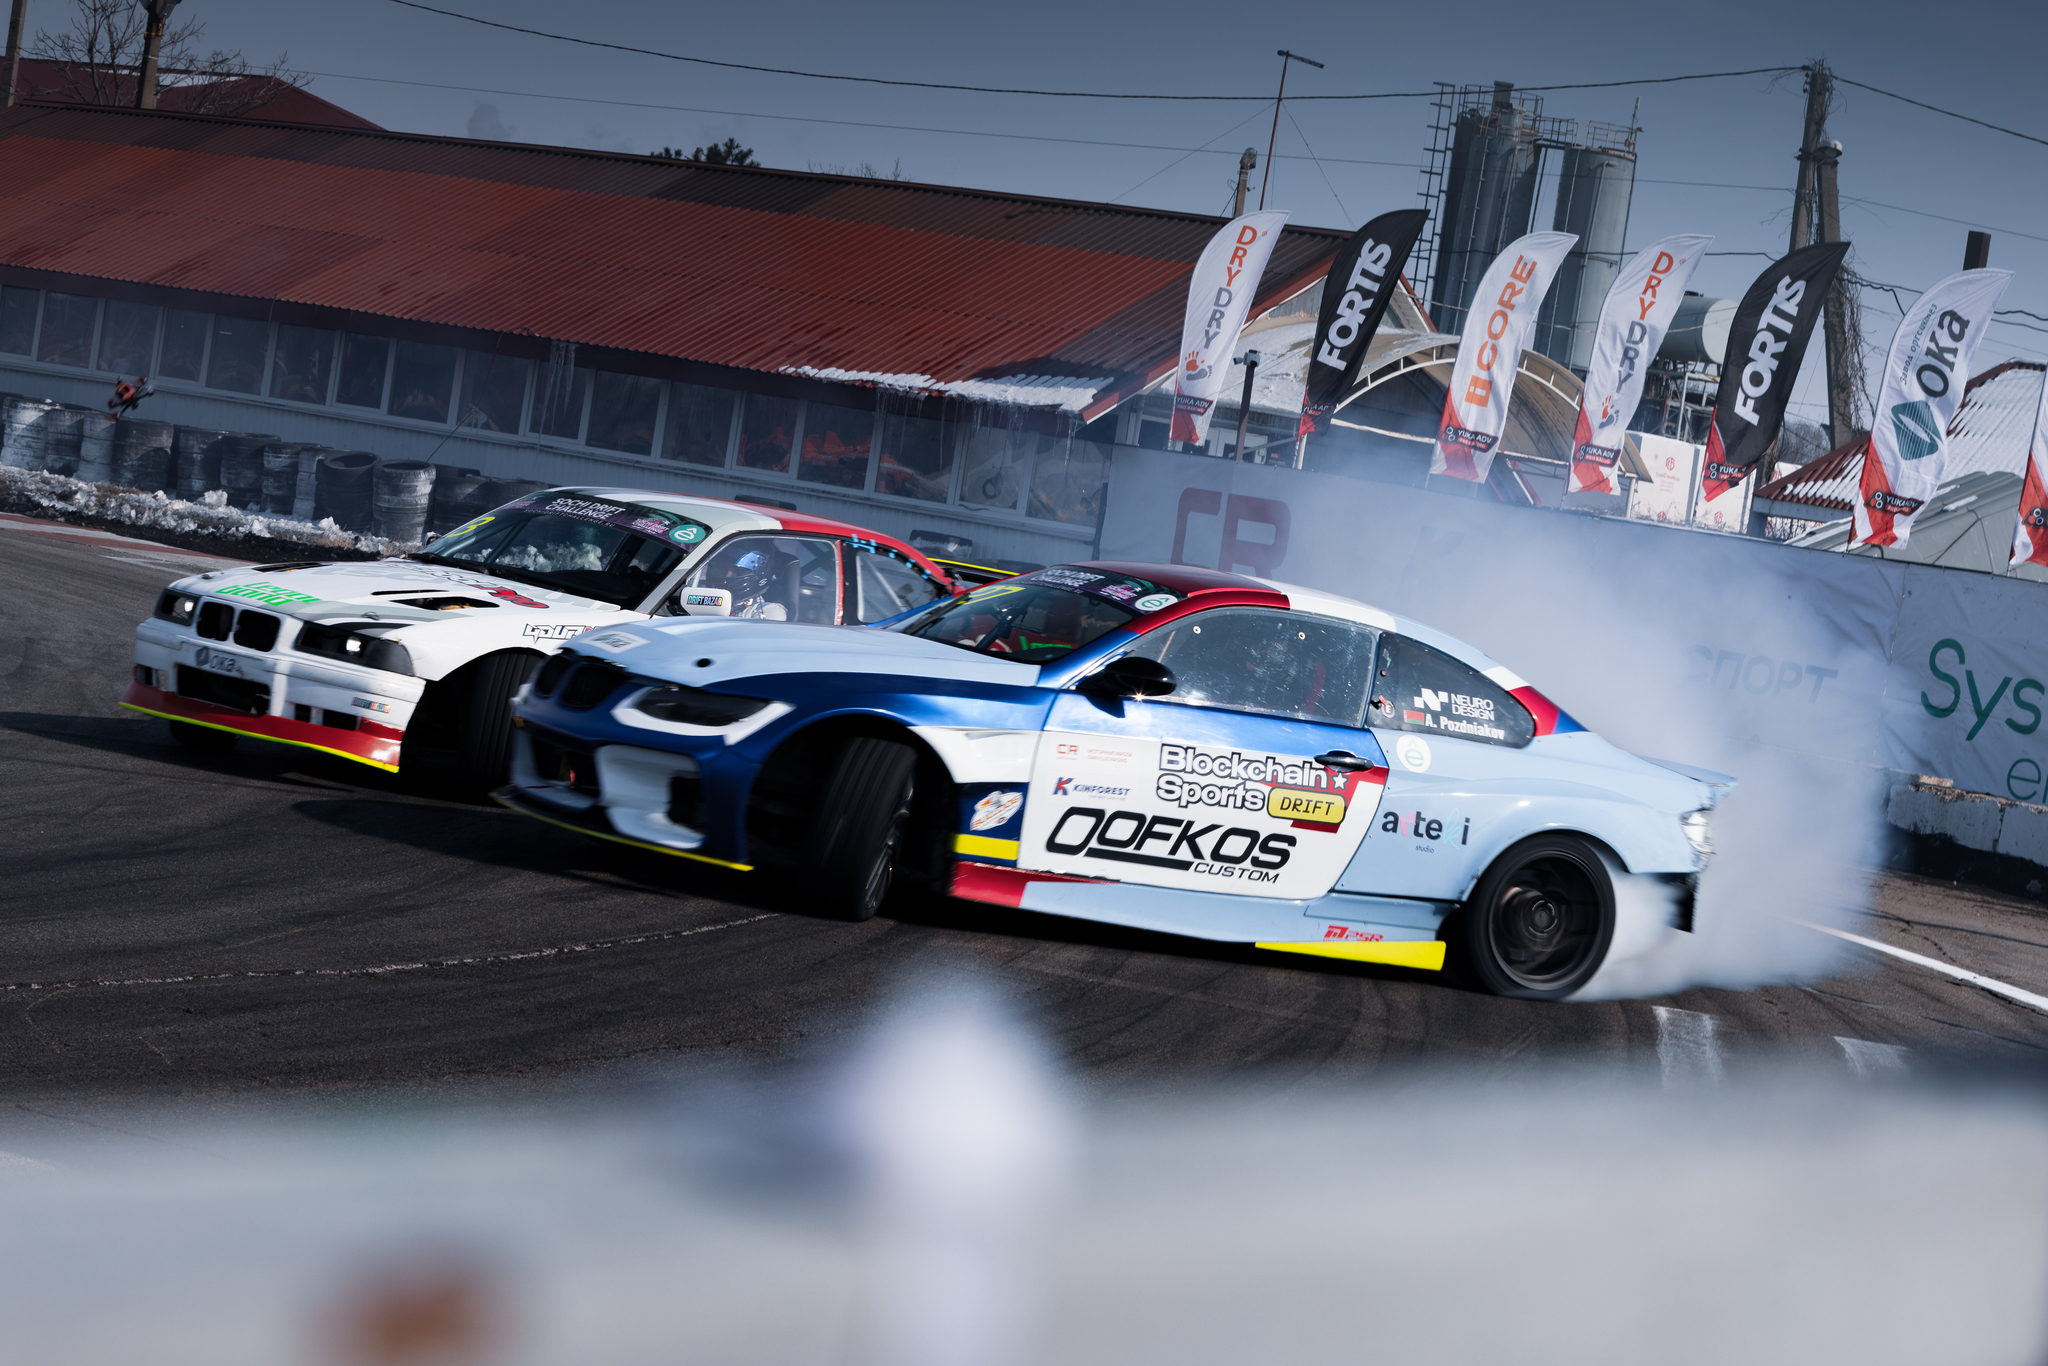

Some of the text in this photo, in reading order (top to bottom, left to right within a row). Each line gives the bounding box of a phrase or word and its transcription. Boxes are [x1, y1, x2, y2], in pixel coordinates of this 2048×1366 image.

[1203, 225, 1258, 350] DRY DRY
[1316, 237, 1393, 372] FORTIS
[1476, 254, 1538, 372] CORE
[1615, 250, 1674, 394] DRY DRY
[1733, 275, 1808, 427] FORTIS
[1176, 396, 1210, 408] YUKA ADV
[1458, 430, 1492, 444] YUKA ADV
[545, 503, 614, 520] CHALLENGE
[551, 497, 592, 508] SOCHI
[588, 502, 627, 515] DRIFT
[1450, 693, 1494, 711] NEURO
[1920, 638, 2046, 742] Sys
[1425, 713, 1505, 740] A. Pozdniakov
[1451, 704, 1495, 721] DESIGN
[1158, 743, 1329, 790] Blockchain
[1156, 773, 1335, 816] Sports DRIFT
[1381, 807, 1471, 851] arteki
[1193, 862, 1281, 884] CUSTOM
